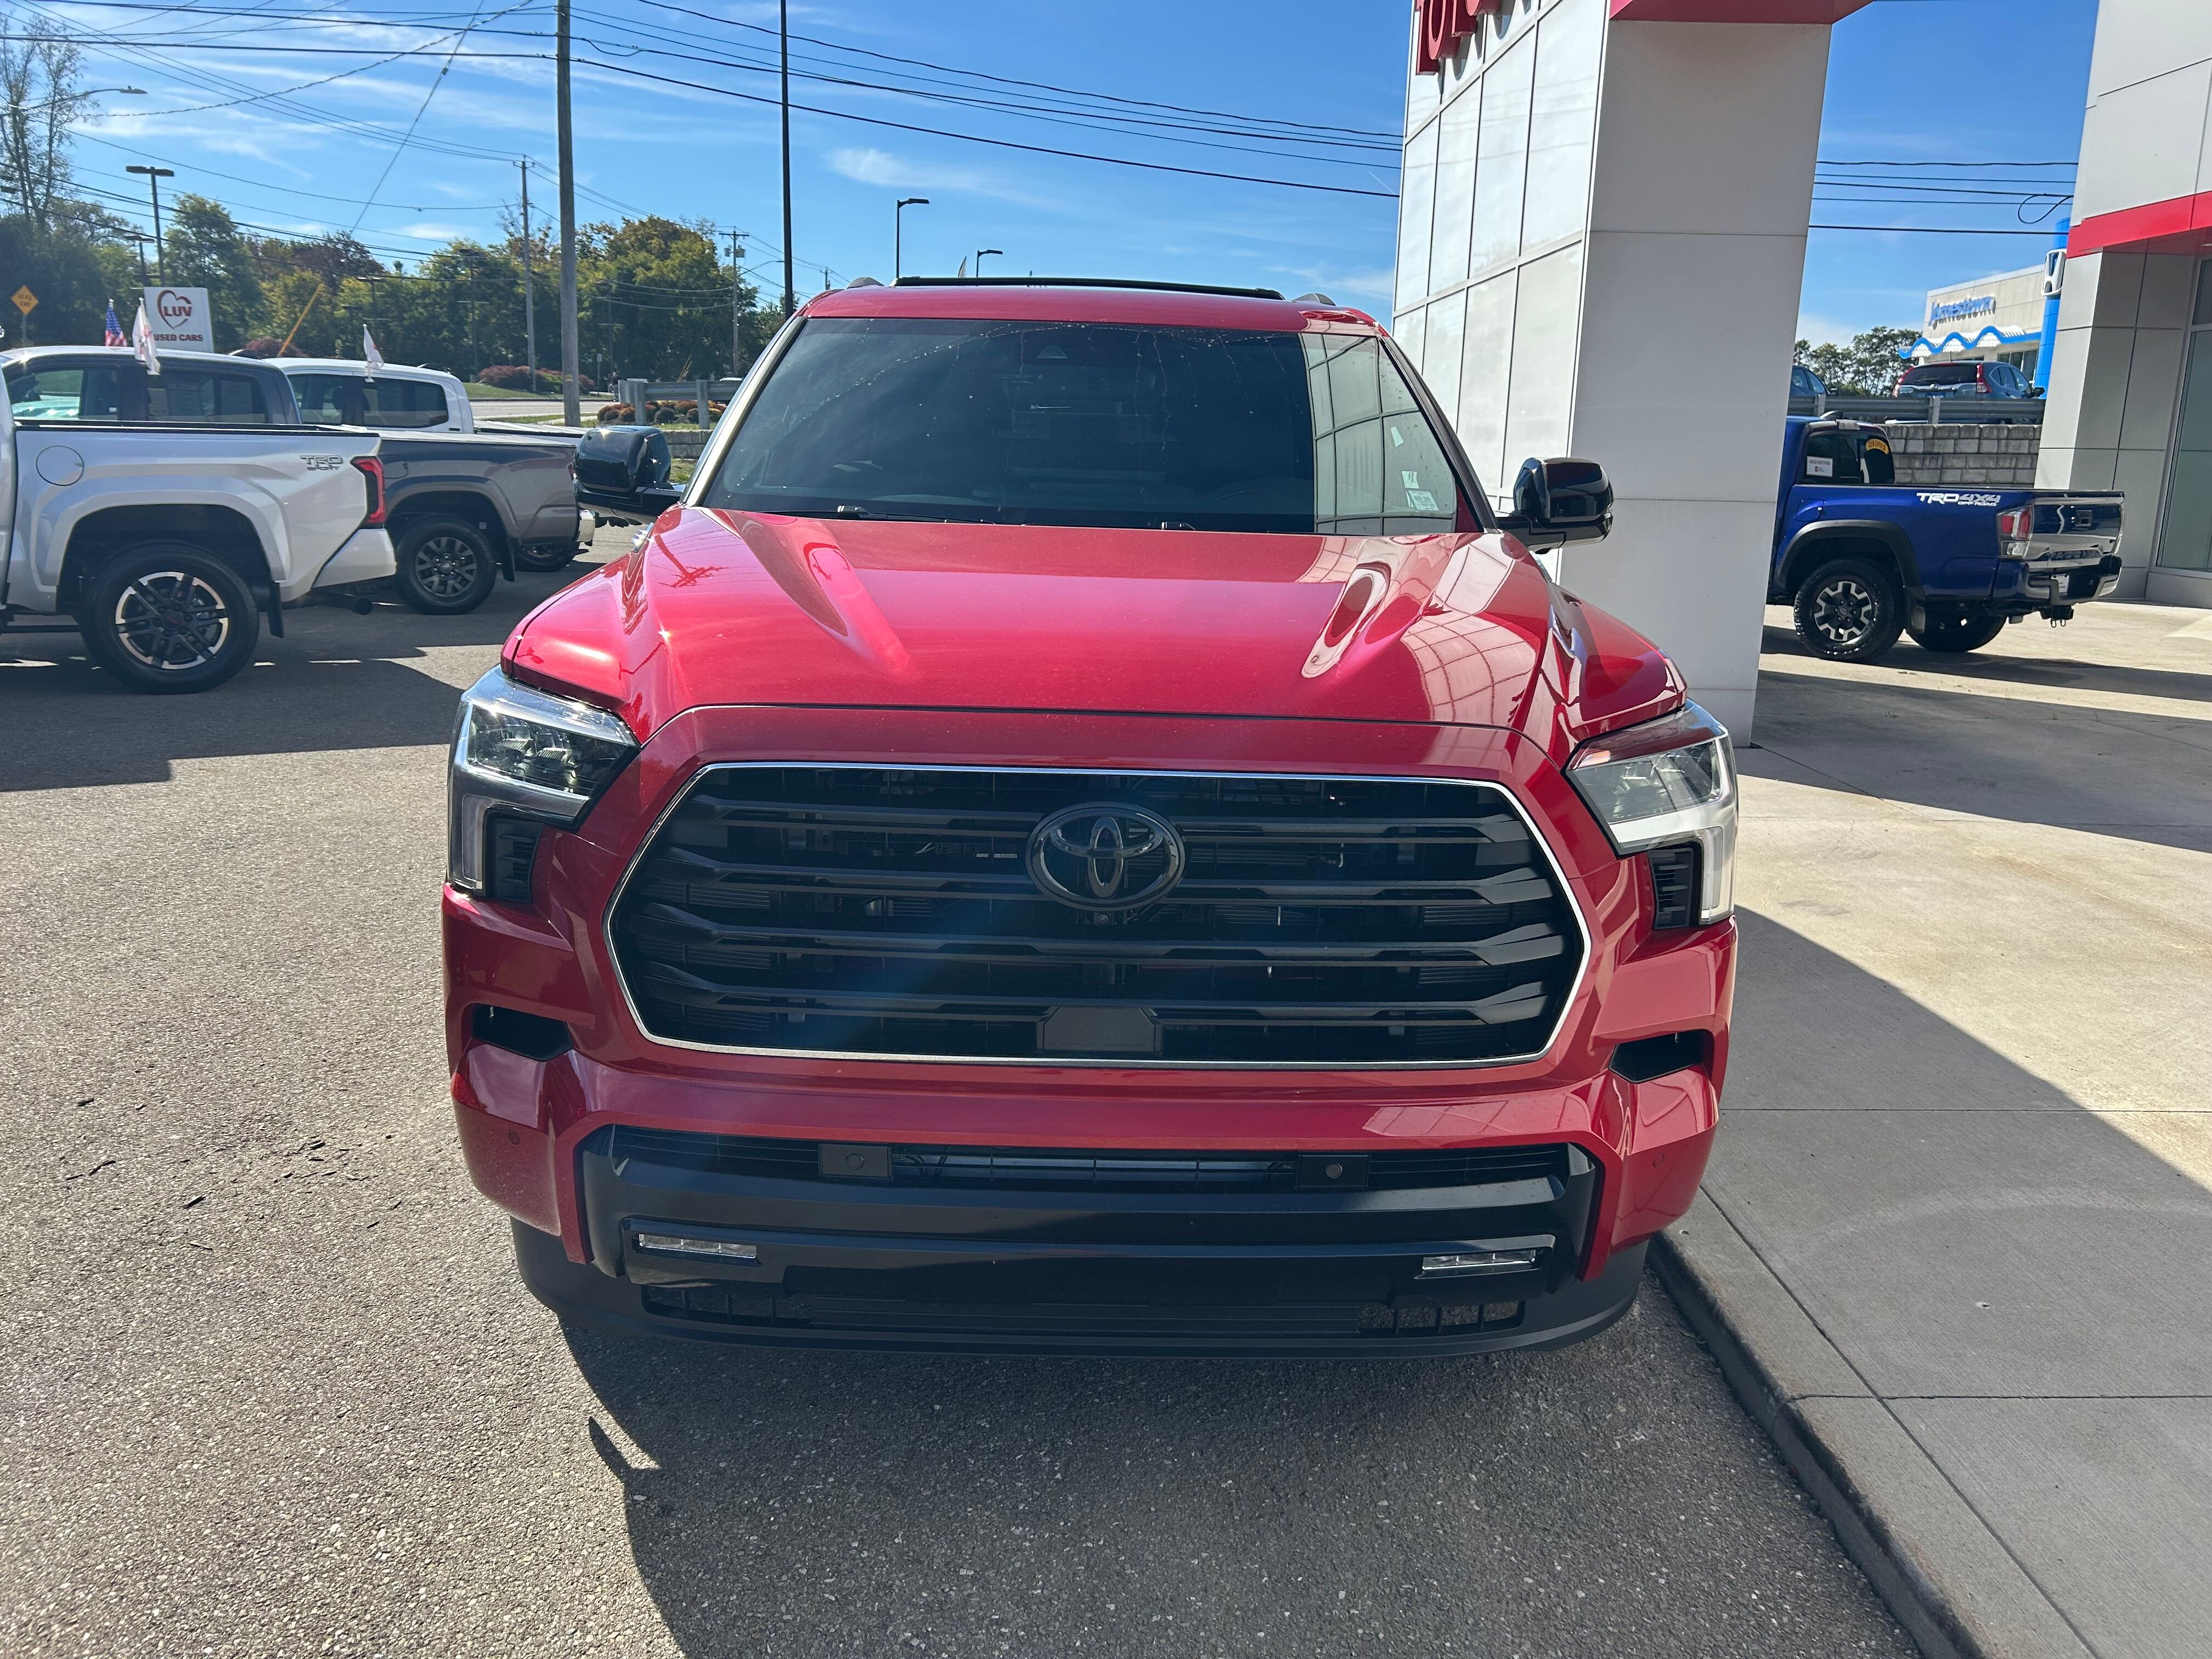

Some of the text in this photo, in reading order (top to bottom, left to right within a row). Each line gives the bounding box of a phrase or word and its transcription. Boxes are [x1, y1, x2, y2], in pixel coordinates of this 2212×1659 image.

[163, 306, 192, 317] LUV
[1928, 297, 1995, 326] Jamestown
[1867, 439, 1886, 452] CERTIFIED
[300, 455, 343, 470] TRD
[1916, 493, 1960, 504] TRD
